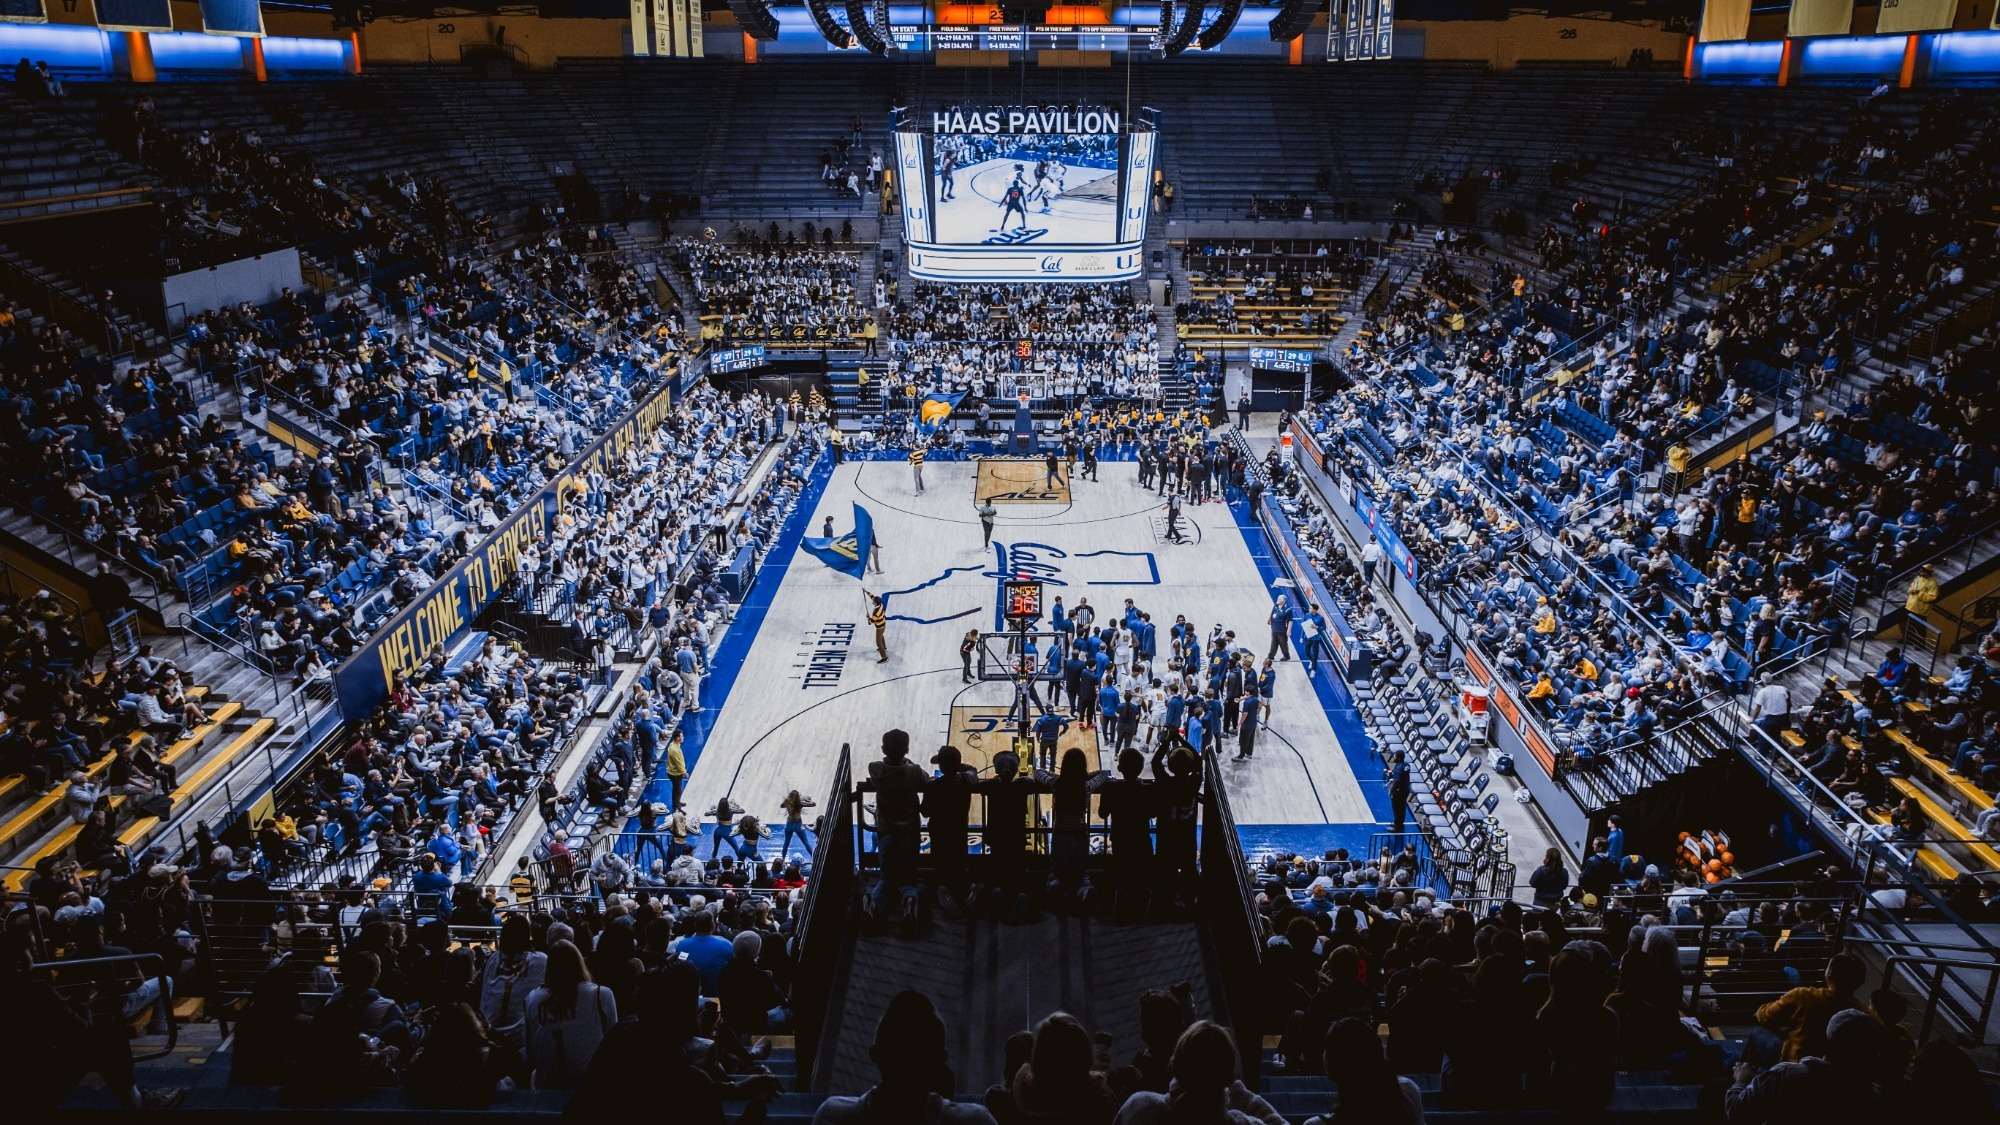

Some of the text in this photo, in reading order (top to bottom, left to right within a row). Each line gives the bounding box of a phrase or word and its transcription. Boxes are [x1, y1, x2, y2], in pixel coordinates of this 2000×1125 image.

[702, 12, 711, 21] 21
[438, 24, 455, 33] 20
[1560, 29, 1577, 39] 26
[934, 112, 1119, 133] HAAS PAVILION
[904, 152, 917, 168] Cal
[1134, 153, 1147, 168] Cal
[1041, 256, 1063, 273] Cal
[744, 328, 756, 336] Cal
[770, 328, 783, 336] Cal
[793, 327, 806, 336] Cal
[816, 326, 829, 335] Cal
[1018, 346, 1030, 357] 30
[1251, 348, 1263, 357] Cal
[604, 439, 614, 471] IS
[615, 420, 634, 460] BEAR
[636, 386, 670, 447] TERRITORY
[378, 499, 545, 695] WELCOME TO BERKELEY
[1014, 596, 1034, 613] 30
[788, 631, 817, 679] COURT
[802, 623, 856, 690] PETE NEWELL
